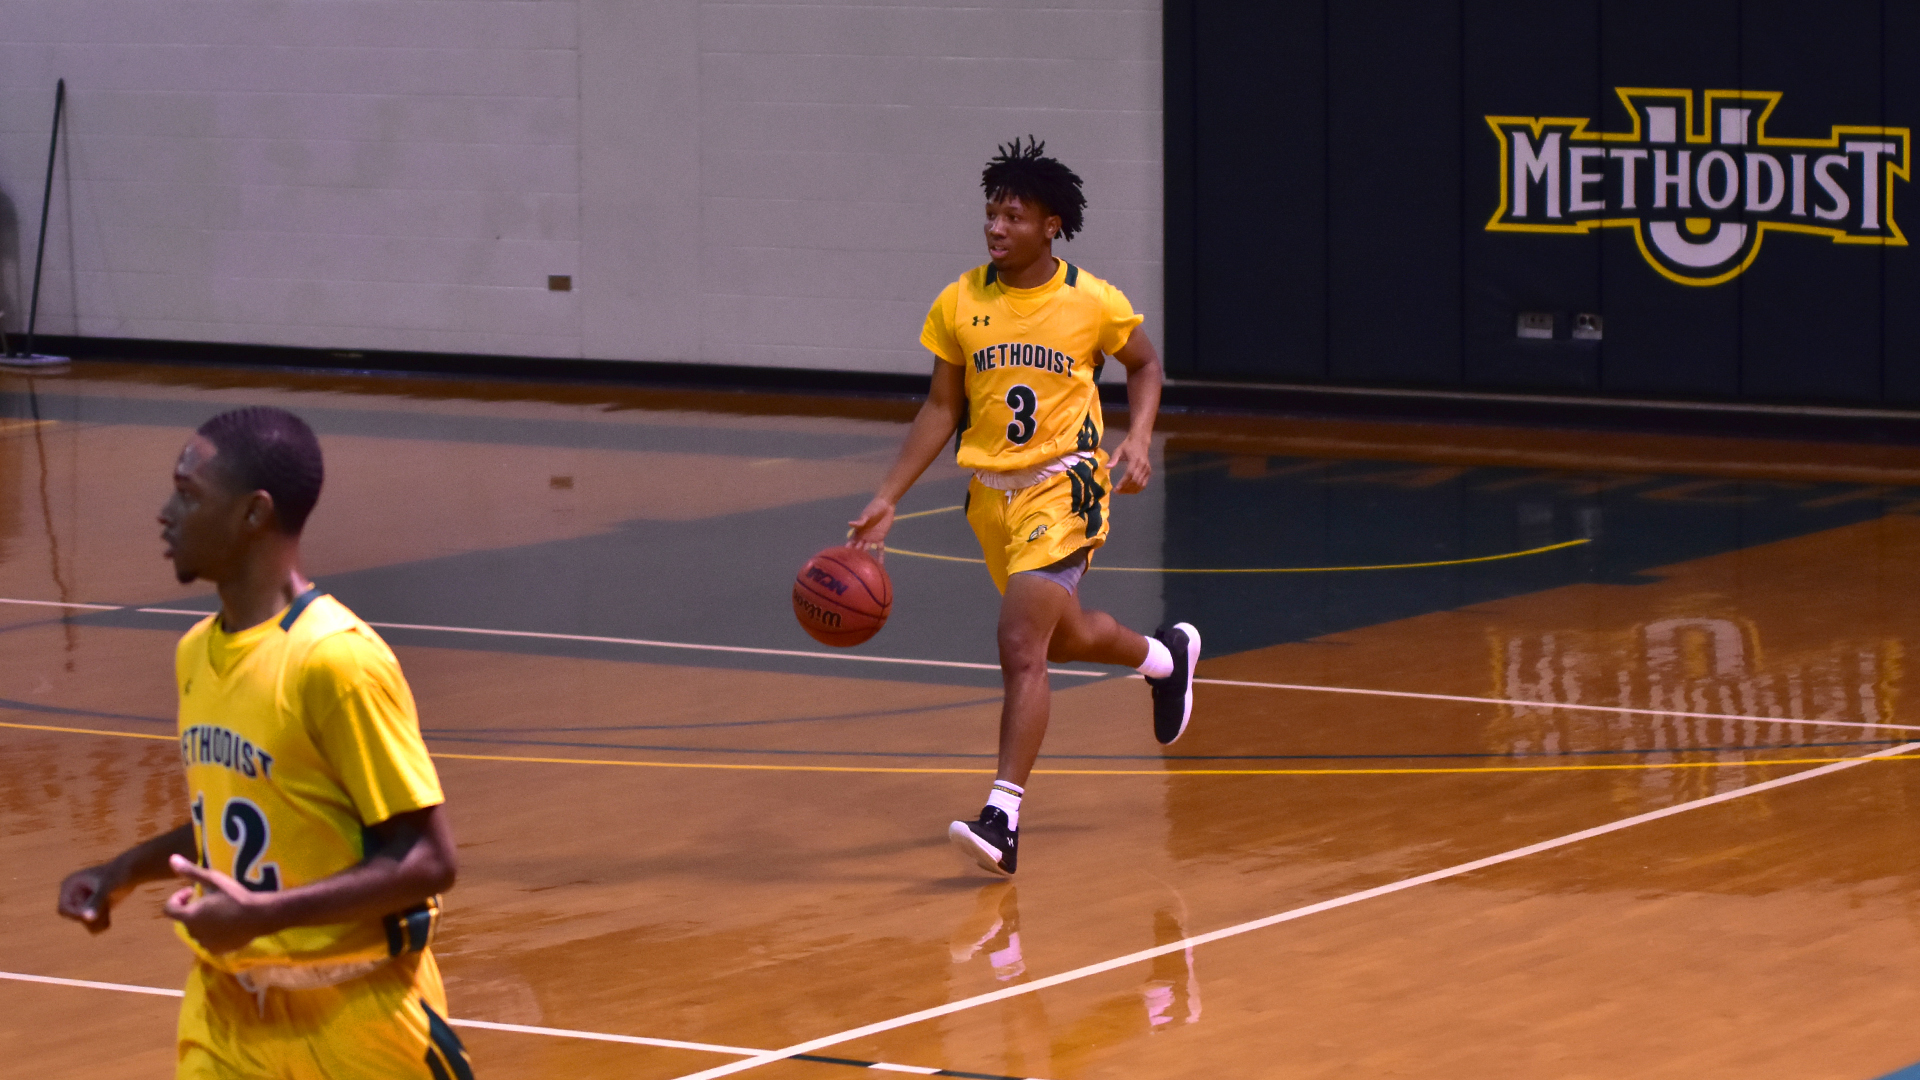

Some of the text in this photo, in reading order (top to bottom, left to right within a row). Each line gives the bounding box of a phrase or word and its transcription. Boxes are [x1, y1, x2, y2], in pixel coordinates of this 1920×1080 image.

[1511, 131, 1896, 230] METHODIST
[972, 342, 1076, 379] METHODIST
[1004, 383, 1039, 447] 3
[181, 723, 275, 780] ETHODIST
